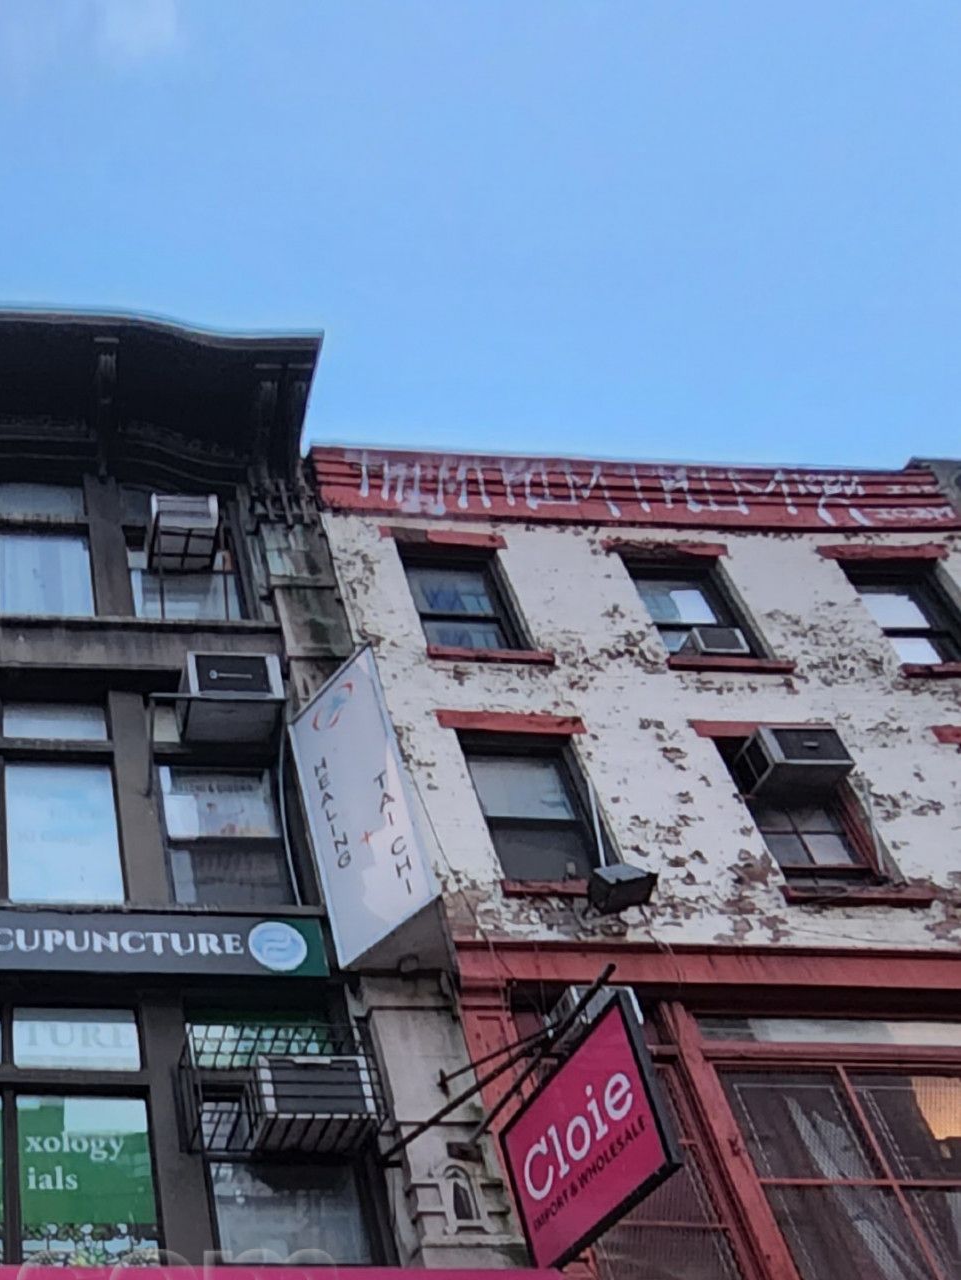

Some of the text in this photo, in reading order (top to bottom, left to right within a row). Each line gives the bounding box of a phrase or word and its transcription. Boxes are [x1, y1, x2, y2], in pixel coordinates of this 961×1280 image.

[314, 757, 351, 869] HEALING
[374, 769, 412, 897] TAI CHI
[524, 1072, 633, 1200] Cloie
